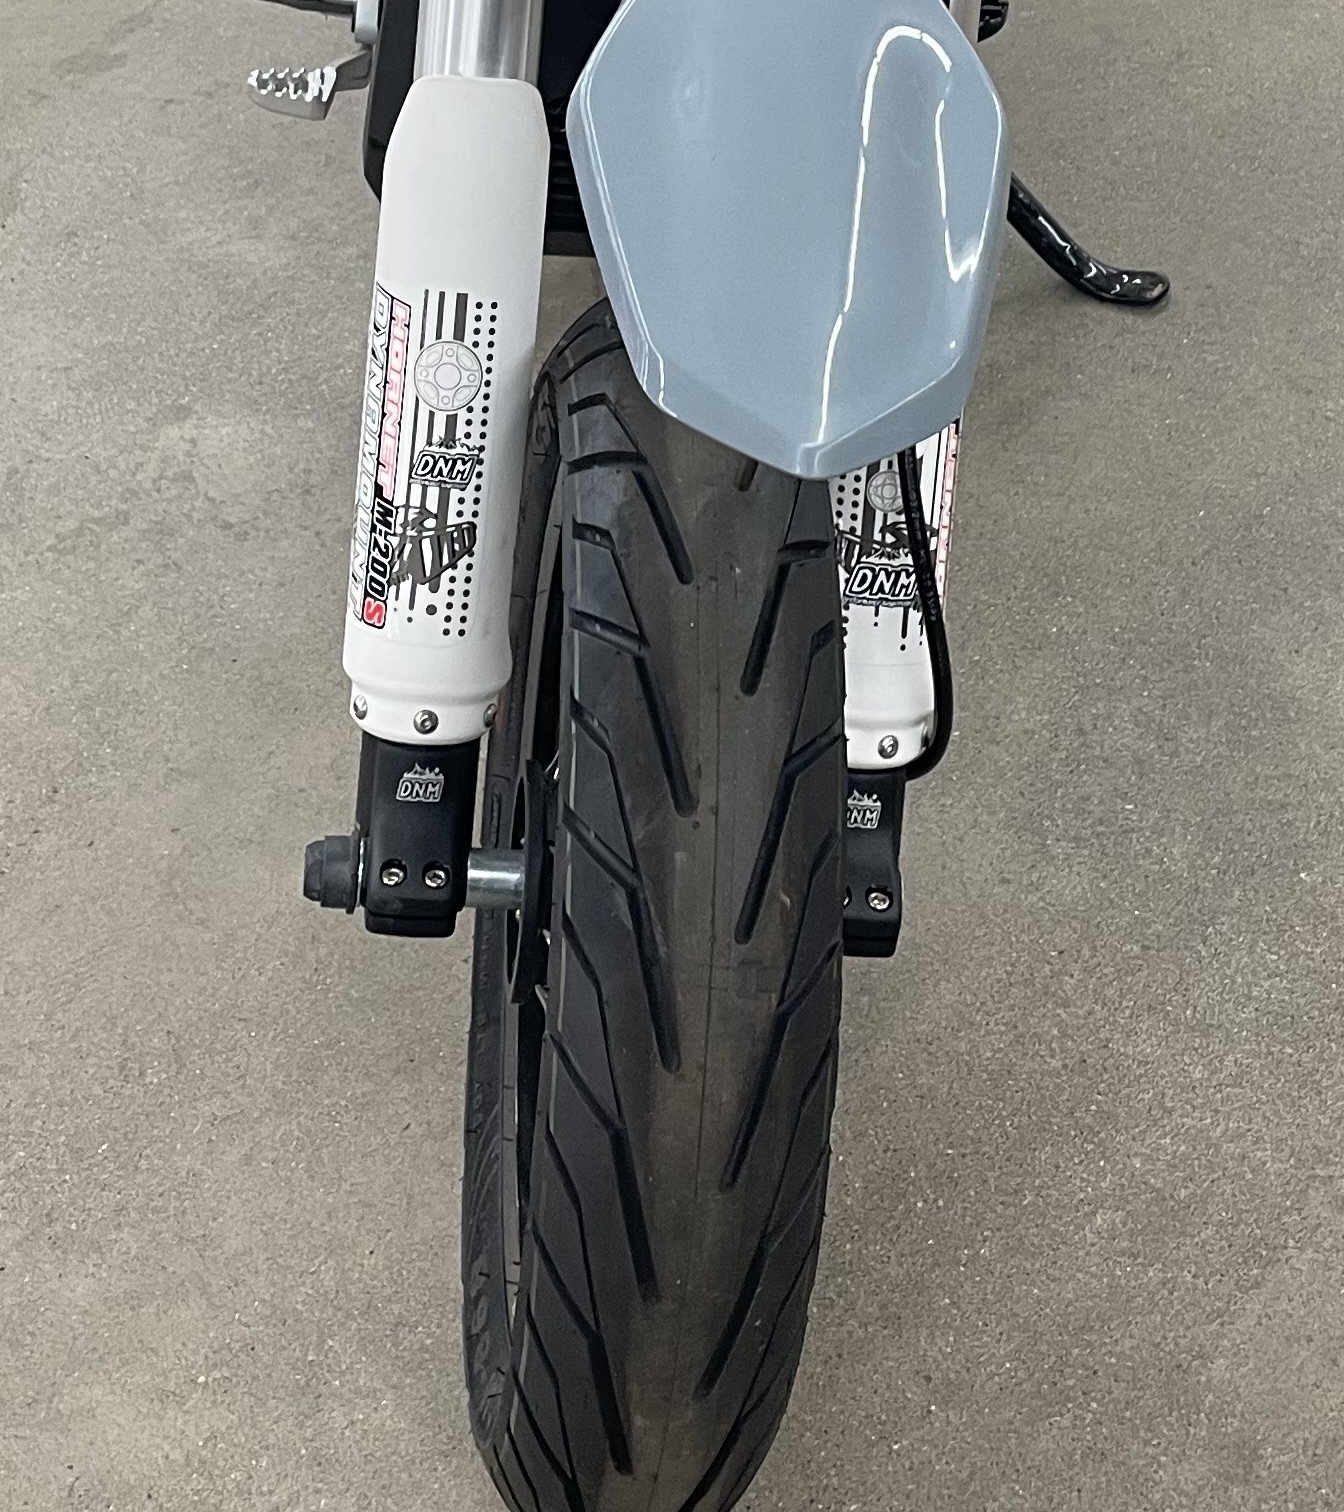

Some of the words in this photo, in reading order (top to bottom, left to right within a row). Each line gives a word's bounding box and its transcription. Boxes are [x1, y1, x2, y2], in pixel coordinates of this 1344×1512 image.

[376, 299, 411, 500] HORNET
[349, 286, 392, 622] DYNAMOUNT
[415, 454, 475, 482] DNM
[850, 566, 917, 597] DNM
[400, 781, 440, 798] DNM
[847, 809, 877, 825] NM
